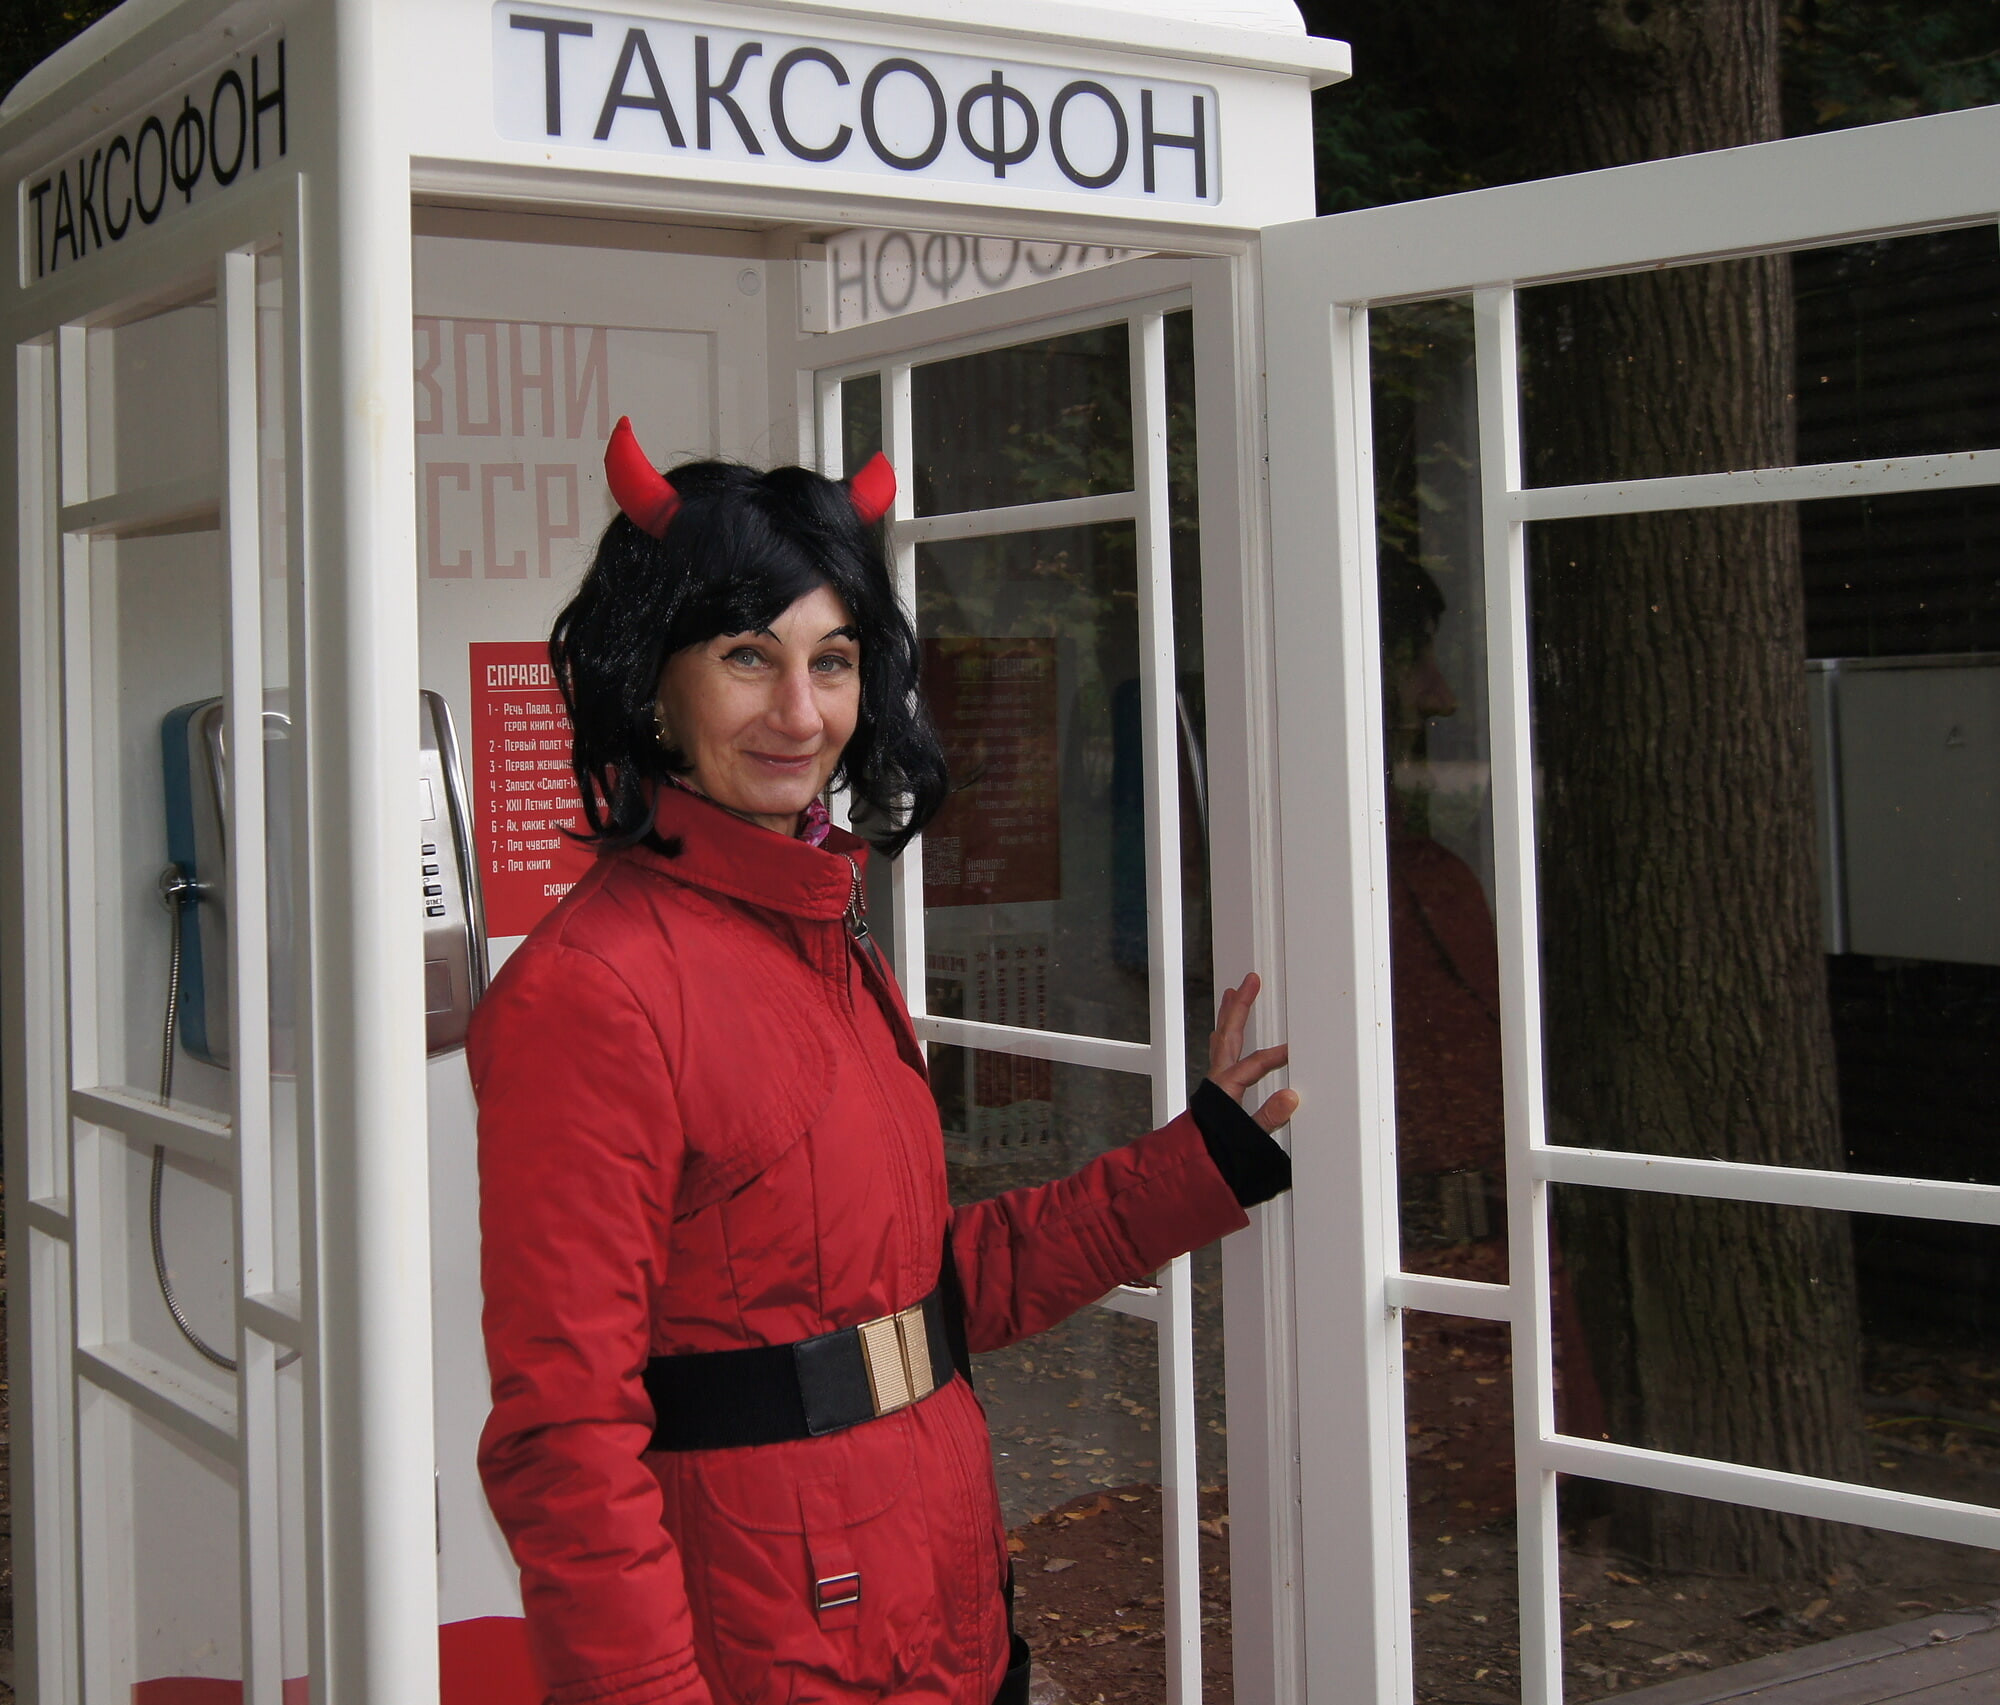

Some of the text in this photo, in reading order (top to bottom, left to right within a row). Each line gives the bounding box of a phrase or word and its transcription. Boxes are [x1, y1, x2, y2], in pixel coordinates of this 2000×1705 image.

[509, 14, 1207, 198] ТАКСОФОН
[29, 39, 286, 278] ТАКСОФОН
[487, 664, 571, 686] СПРАВО
[530, 720, 554, 731] книги
[489, 741, 495, 752] 2
[489, 761, 495, 773] 3
[490, 780, 496, 792] 4
[491, 801, 496, 813] 5
[491, 821, 497, 832] 6
[492, 841, 497, 853] 7
[492, 861, 498, 873] 8
[527, 859, 551, 871] книги
